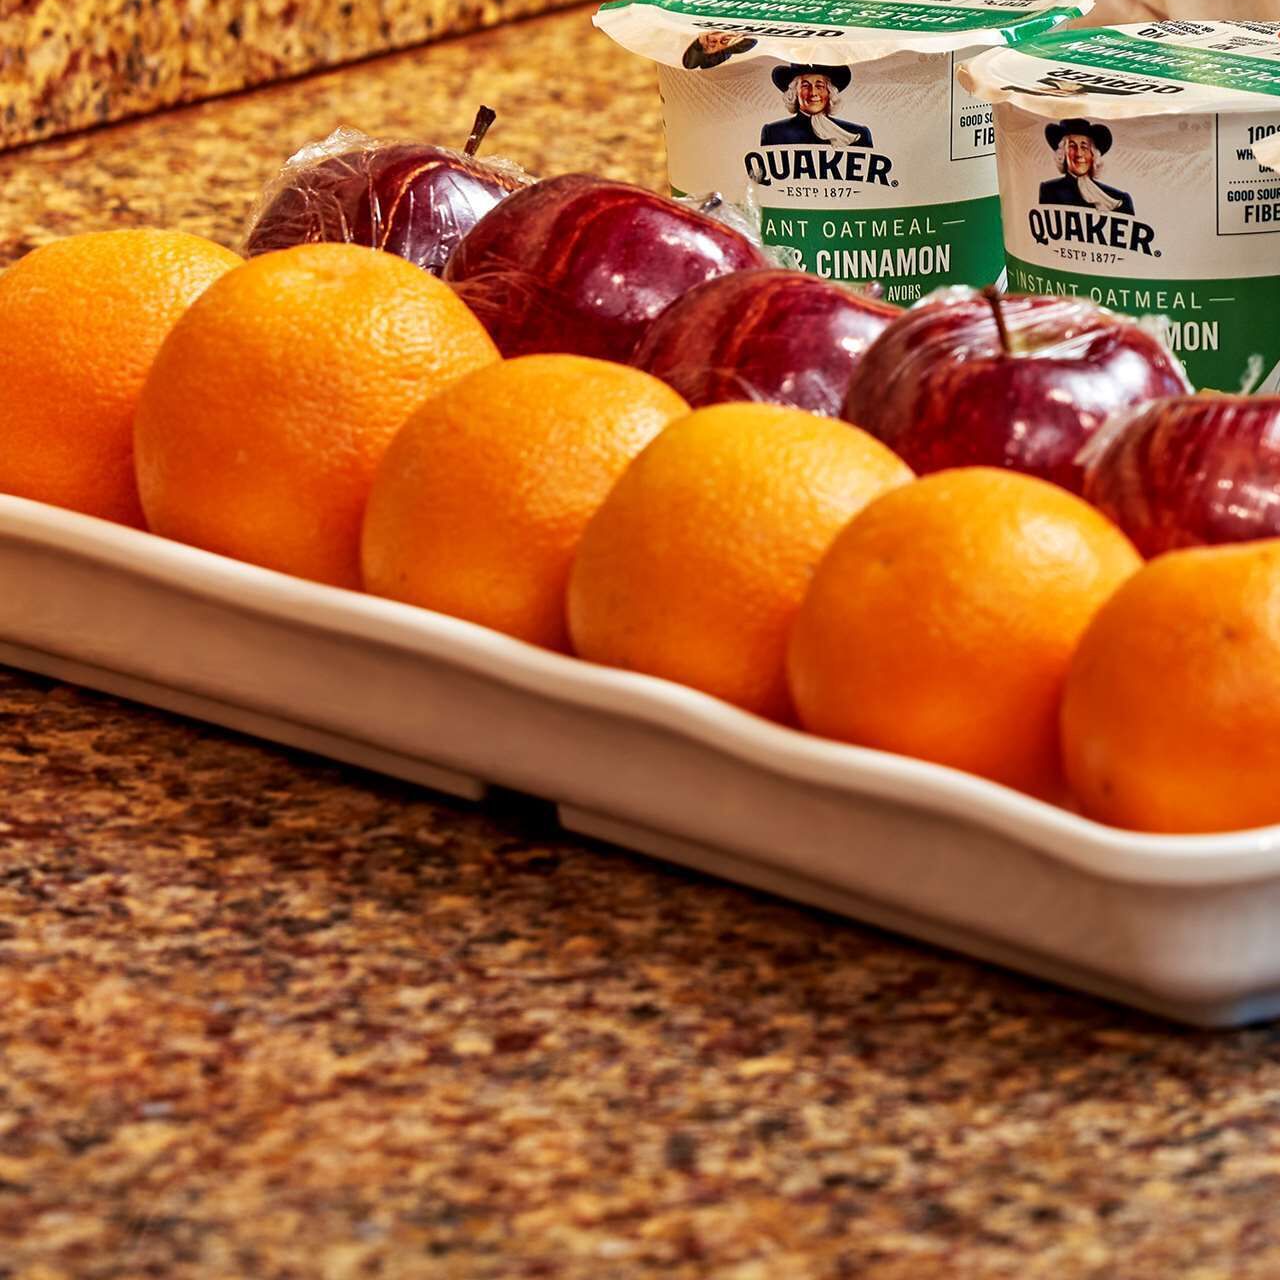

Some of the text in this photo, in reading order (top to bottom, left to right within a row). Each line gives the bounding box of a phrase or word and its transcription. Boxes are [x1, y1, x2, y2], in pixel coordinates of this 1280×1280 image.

[825, 7, 848, 16] &
[851, 8, 966, 23] APPLES
[692, 21, 846, 38] QUAKER
[1136, 28, 1169, 39] NO
[1057, 41, 1195, 67] CINNAMON
[1057, 52, 1160, 71] OATMEAL
[1195, 63, 1221, 72] &
[1046, 69, 1185, 94] QUAKER
[960, 114, 983, 127] GOOD
[974, 127, 994, 147] FIB
[744, 149, 893, 187] QUAKER
[823, 187, 852, 198] 1877
[1227, 190, 1255, 202] GOOD
[822, 217, 936, 238] OATMEAL
[1028, 208, 1155, 257] QUAKER
[816, 244, 951, 279] CINNAMON
[1090, 251, 1117, 264] 1877
[888, 284, 921, 301] AVORS
[1015, 269, 1202, 309] INSTANT OATMEAL
